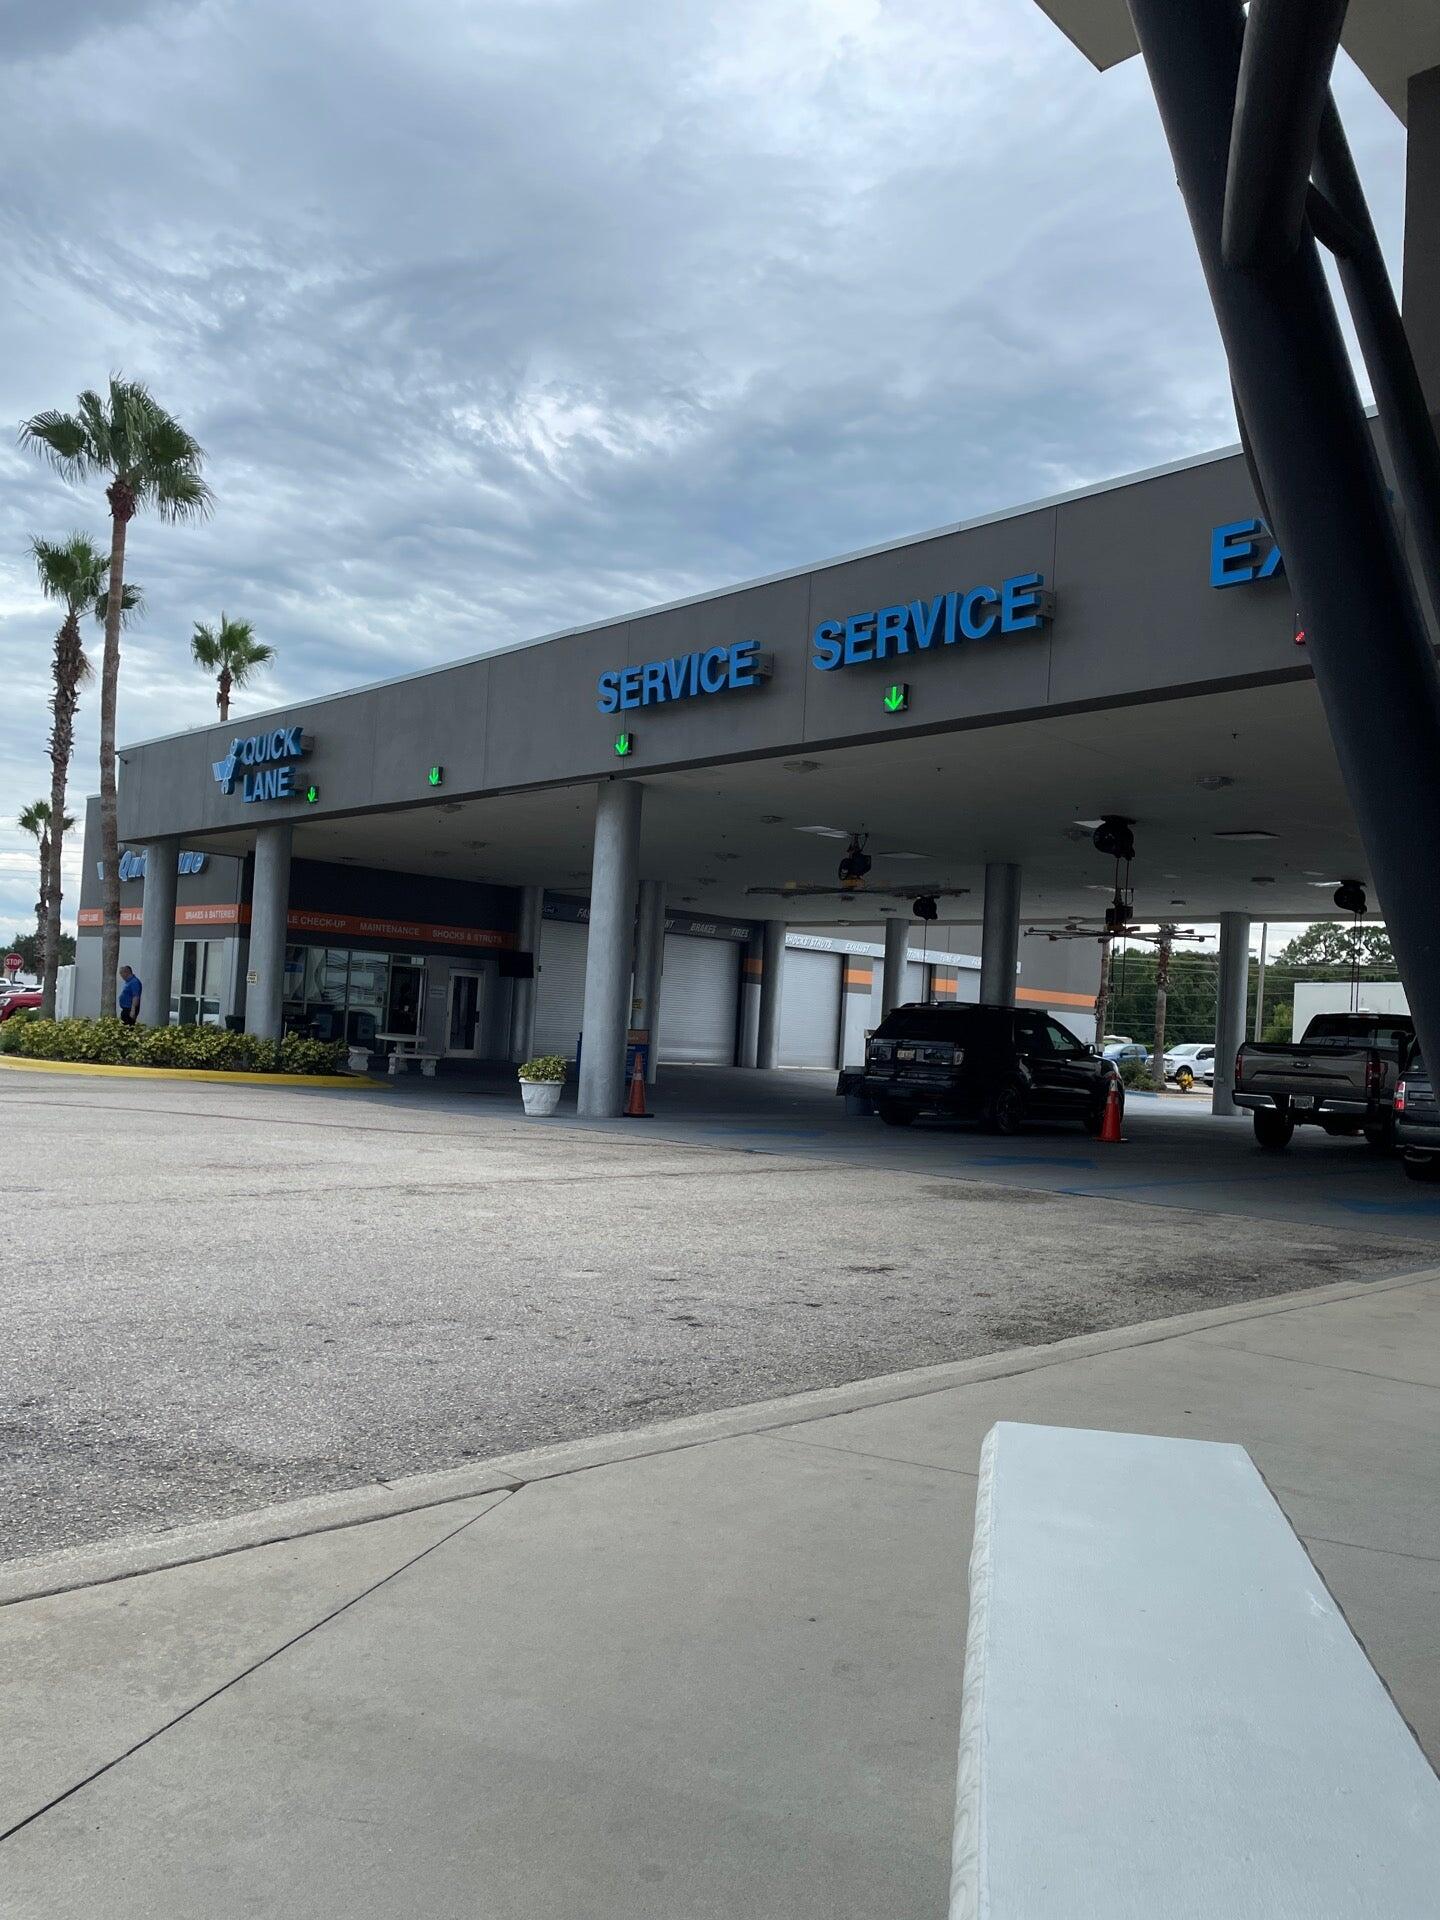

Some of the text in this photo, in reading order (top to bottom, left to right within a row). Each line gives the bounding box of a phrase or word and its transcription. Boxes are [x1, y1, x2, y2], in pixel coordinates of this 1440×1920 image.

[812, 572, 1044, 671] SERVICE
[597, 640, 761, 713] SERVICE
[241, 727, 303, 765] QUICK
[242, 766, 293, 803] LANE
[185, 910, 204, 920] BRAKES
[208, 909, 236, 919] BATTERIES
[301, 916, 346, 928] CHECK-UP
[360, 922, 421, 936] MAINTENANCE
[432, 929, 465, 941] SHOCKS
[473, 933, 502, 944] STRUTS
[690, 922, 717, 935] BRAKES
[731, 927, 749, 938] TIRES
[6, 958, 22, 966] STOP
